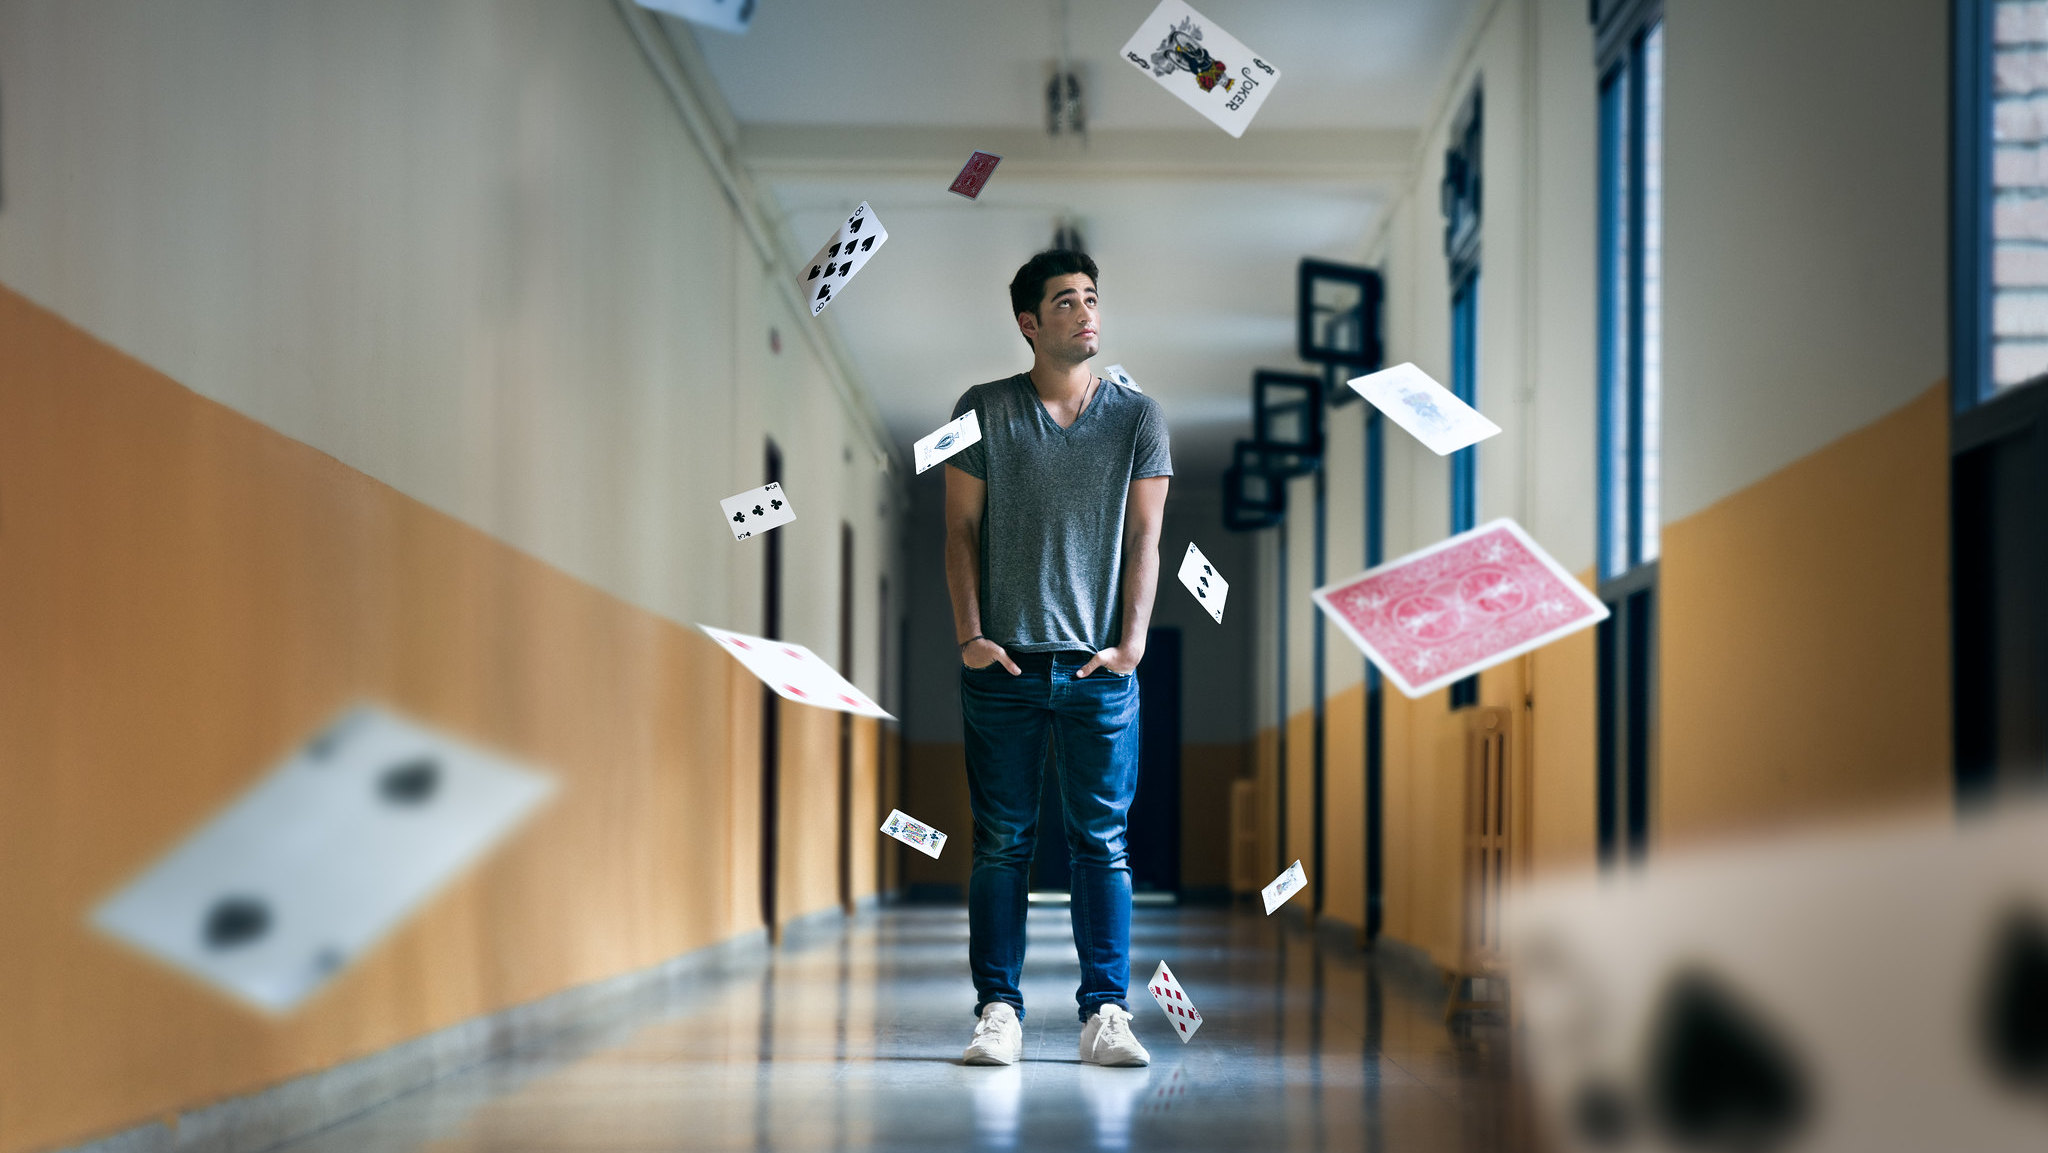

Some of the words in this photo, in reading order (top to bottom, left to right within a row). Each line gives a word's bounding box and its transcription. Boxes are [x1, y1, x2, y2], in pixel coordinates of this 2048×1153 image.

[1225, 66, 1259, 111] JOKER
[855, 206, 864, 216] 8
[815, 302, 825, 312] 8
